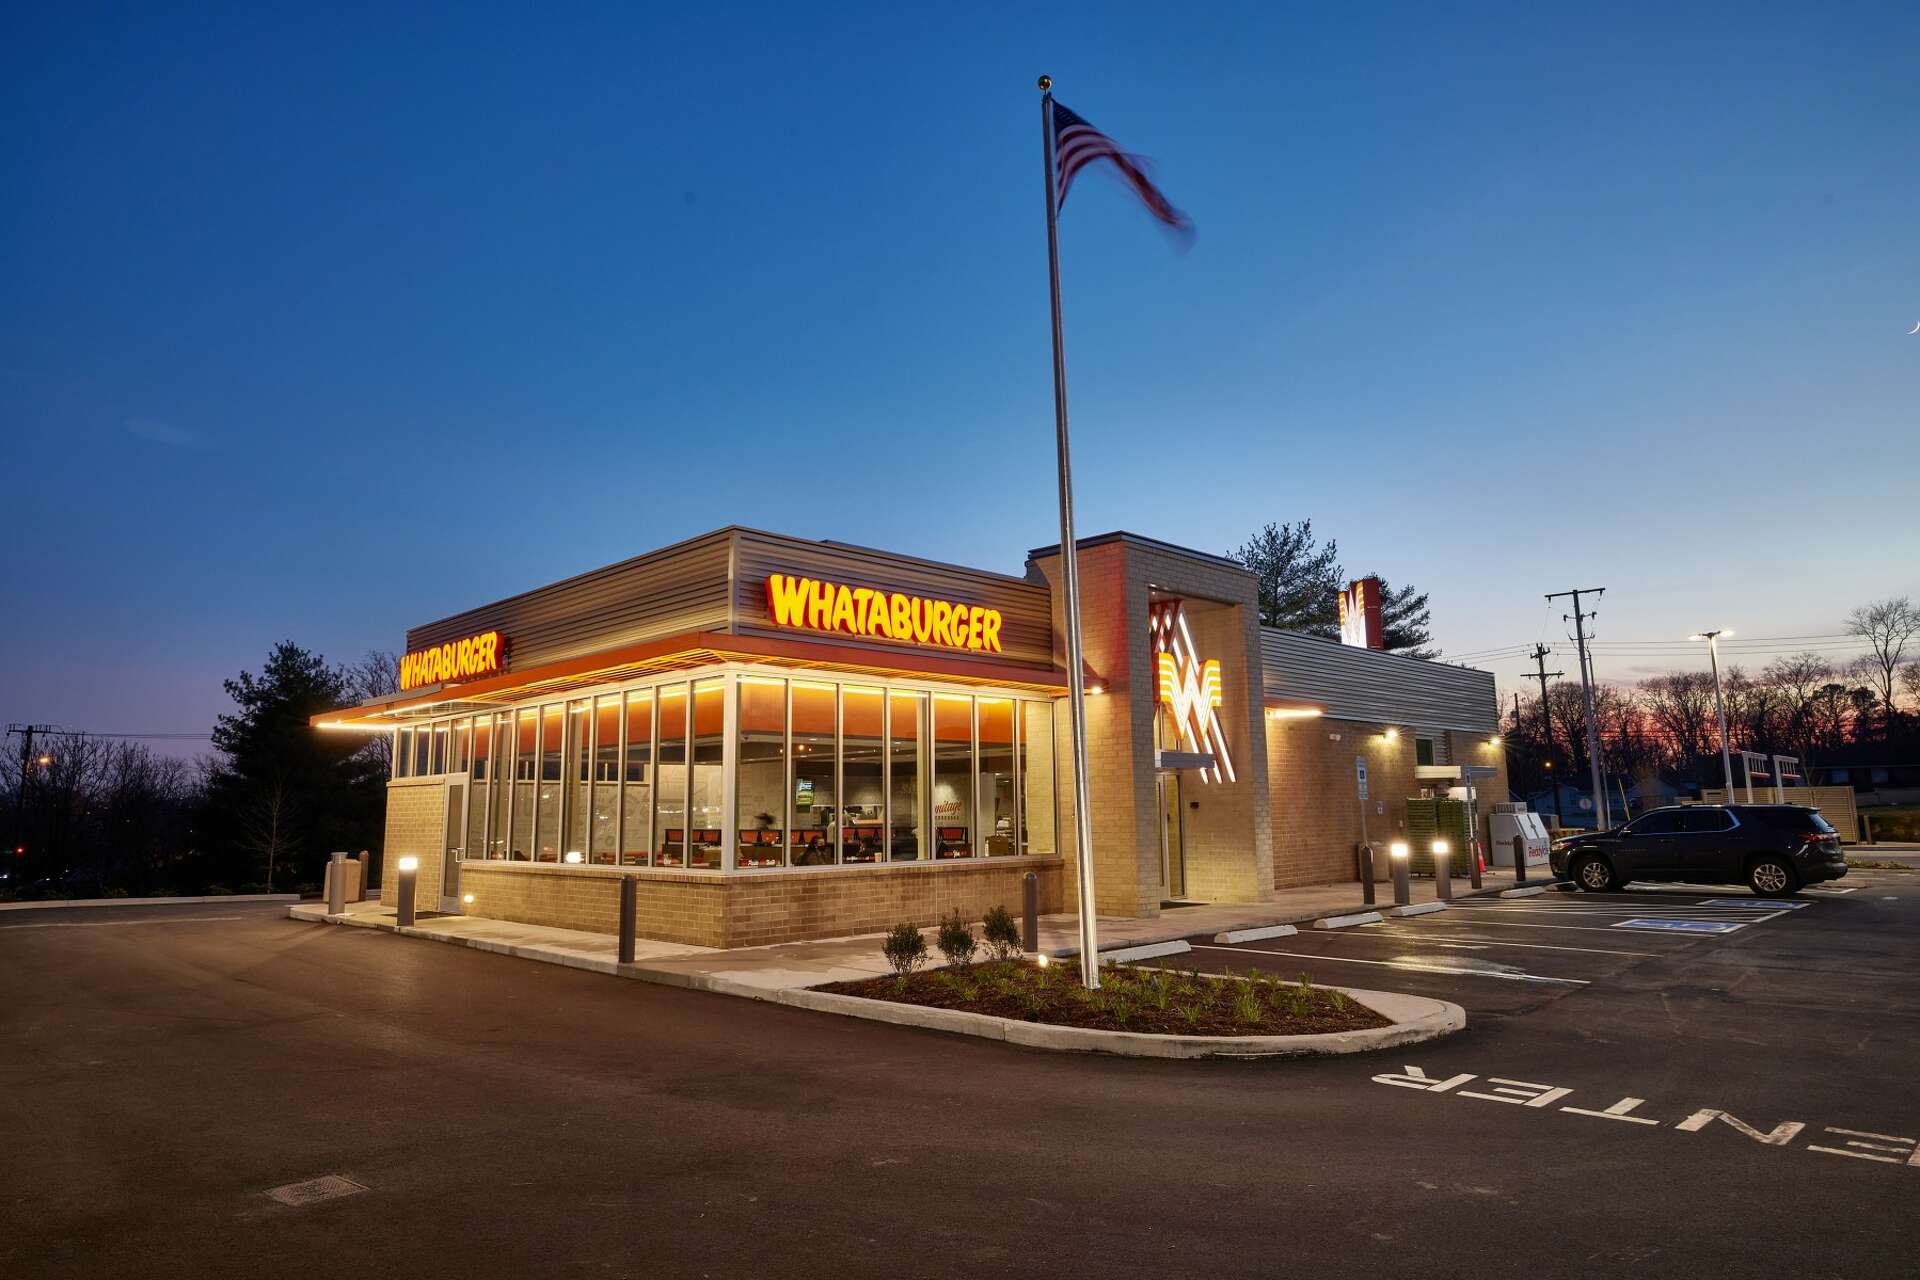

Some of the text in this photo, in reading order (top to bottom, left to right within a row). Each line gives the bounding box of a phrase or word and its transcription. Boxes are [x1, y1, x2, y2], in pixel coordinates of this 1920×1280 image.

[769, 574, 1002, 653] WHATABURGER
[400, 631, 497, 690] WHATABURGER
[1370, 1064, 1920, 1167] ENTER
